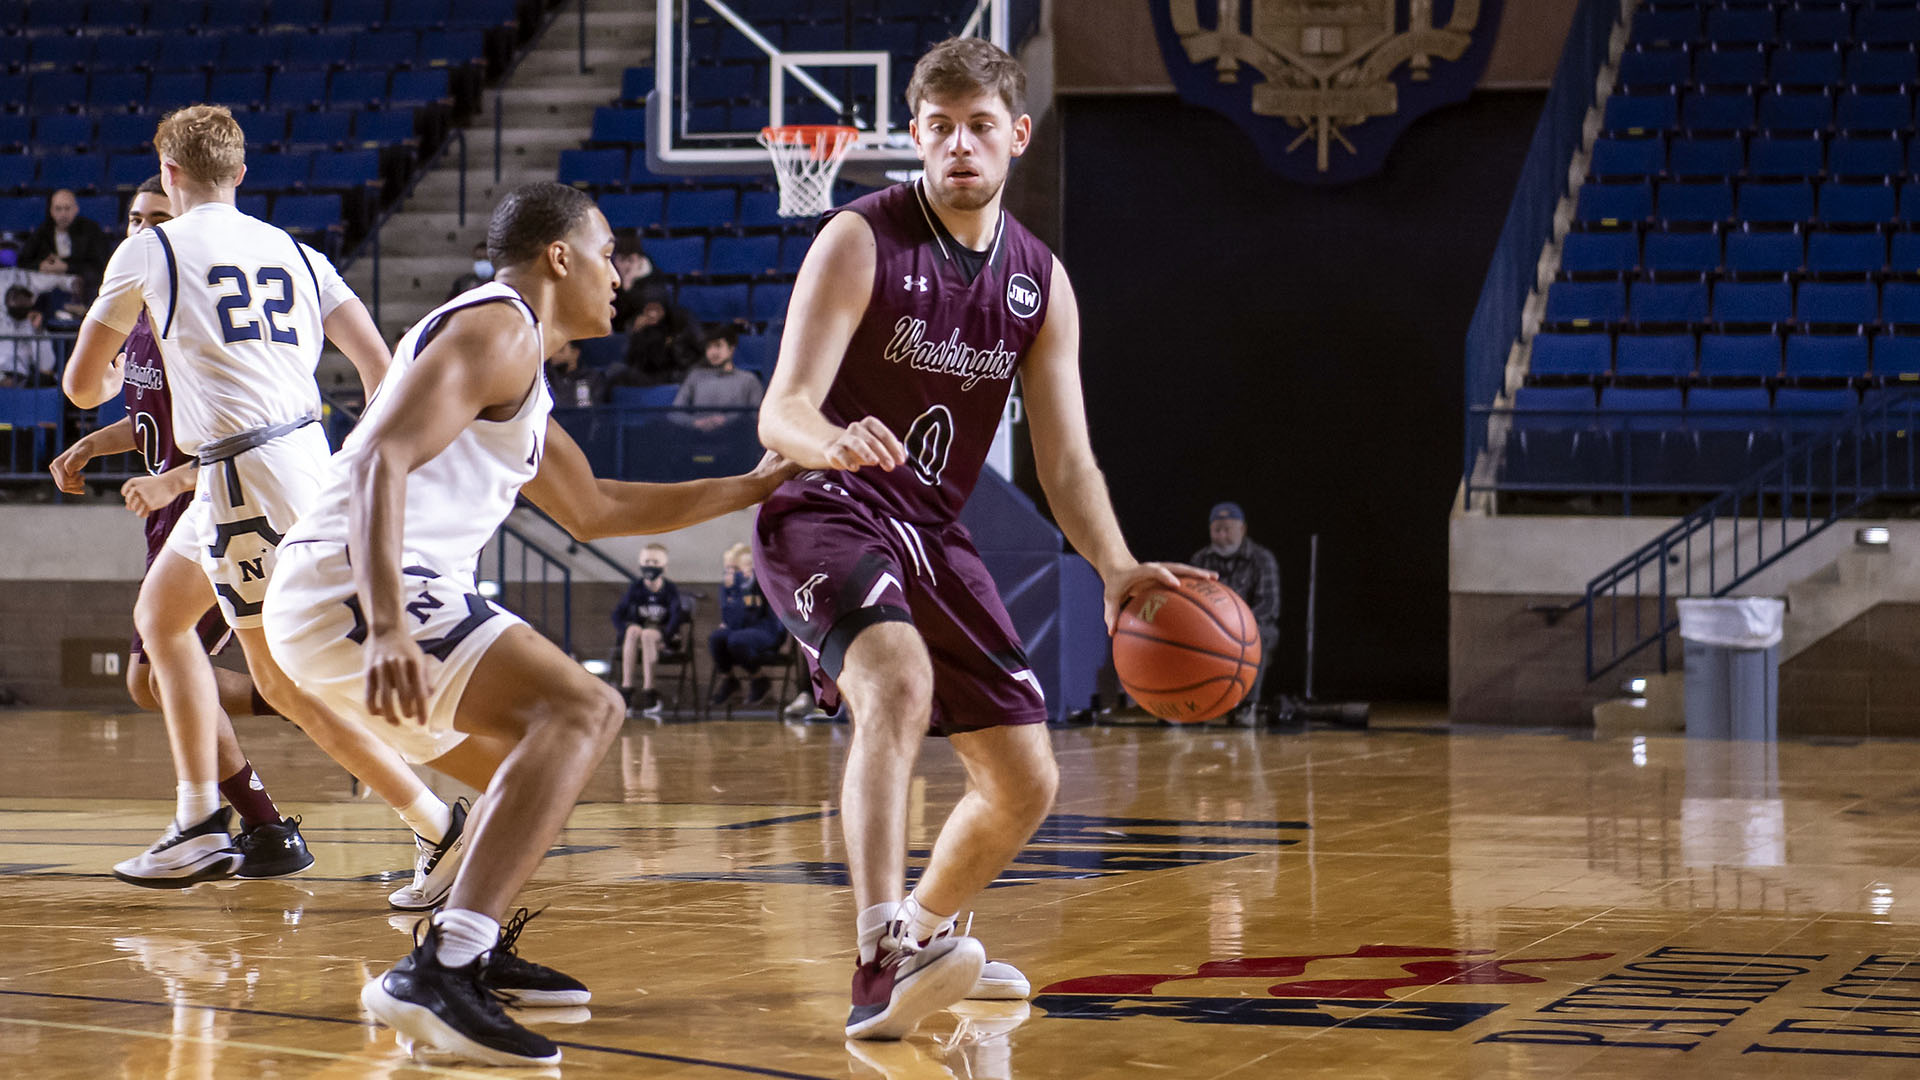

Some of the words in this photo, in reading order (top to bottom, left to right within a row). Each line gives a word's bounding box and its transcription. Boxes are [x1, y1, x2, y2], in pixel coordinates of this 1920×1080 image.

[207, 263, 299, 346] 22
[1009, 284, 1038, 308] JNW
[884, 315, 1018, 392] Washington
[904, 404, 954, 486] 0
[238, 556, 266, 583] N
[405, 590, 445, 625] N
[1472, 946, 1830, 1053] PATRIOT
